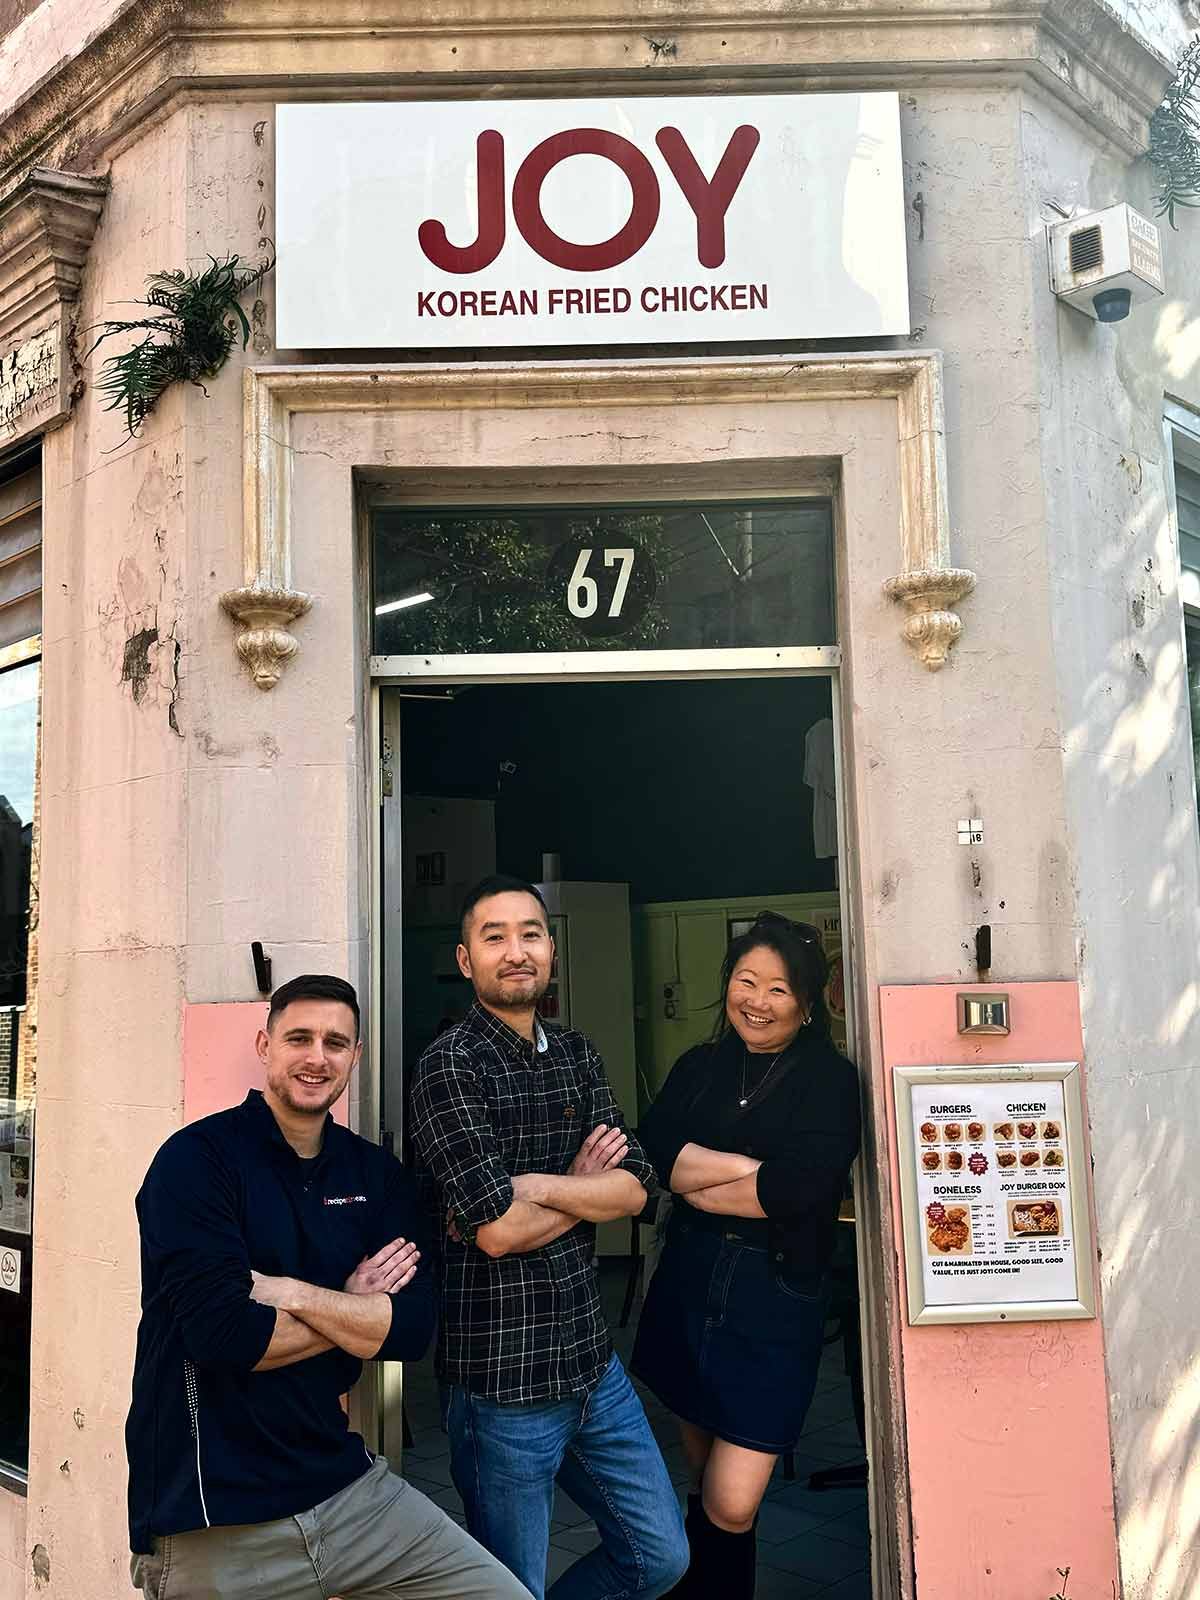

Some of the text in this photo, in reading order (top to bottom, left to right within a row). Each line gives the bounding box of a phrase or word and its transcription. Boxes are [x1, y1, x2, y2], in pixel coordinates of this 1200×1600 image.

[418, 125, 761, 274] JOY
[418, 284, 768, 316] KOREAN FRIED CHICKEN
[565, 548, 635, 619] 67
[972, 833, 982, 843] 18
[930, 1104, 972, 1114] BURGERS
[1006, 1102, 1046, 1113] CHICKEN
[933, 1185, 982, 1195] BONELESS
[1000, 1181, 1066, 1192] JOY BURGER BOX
